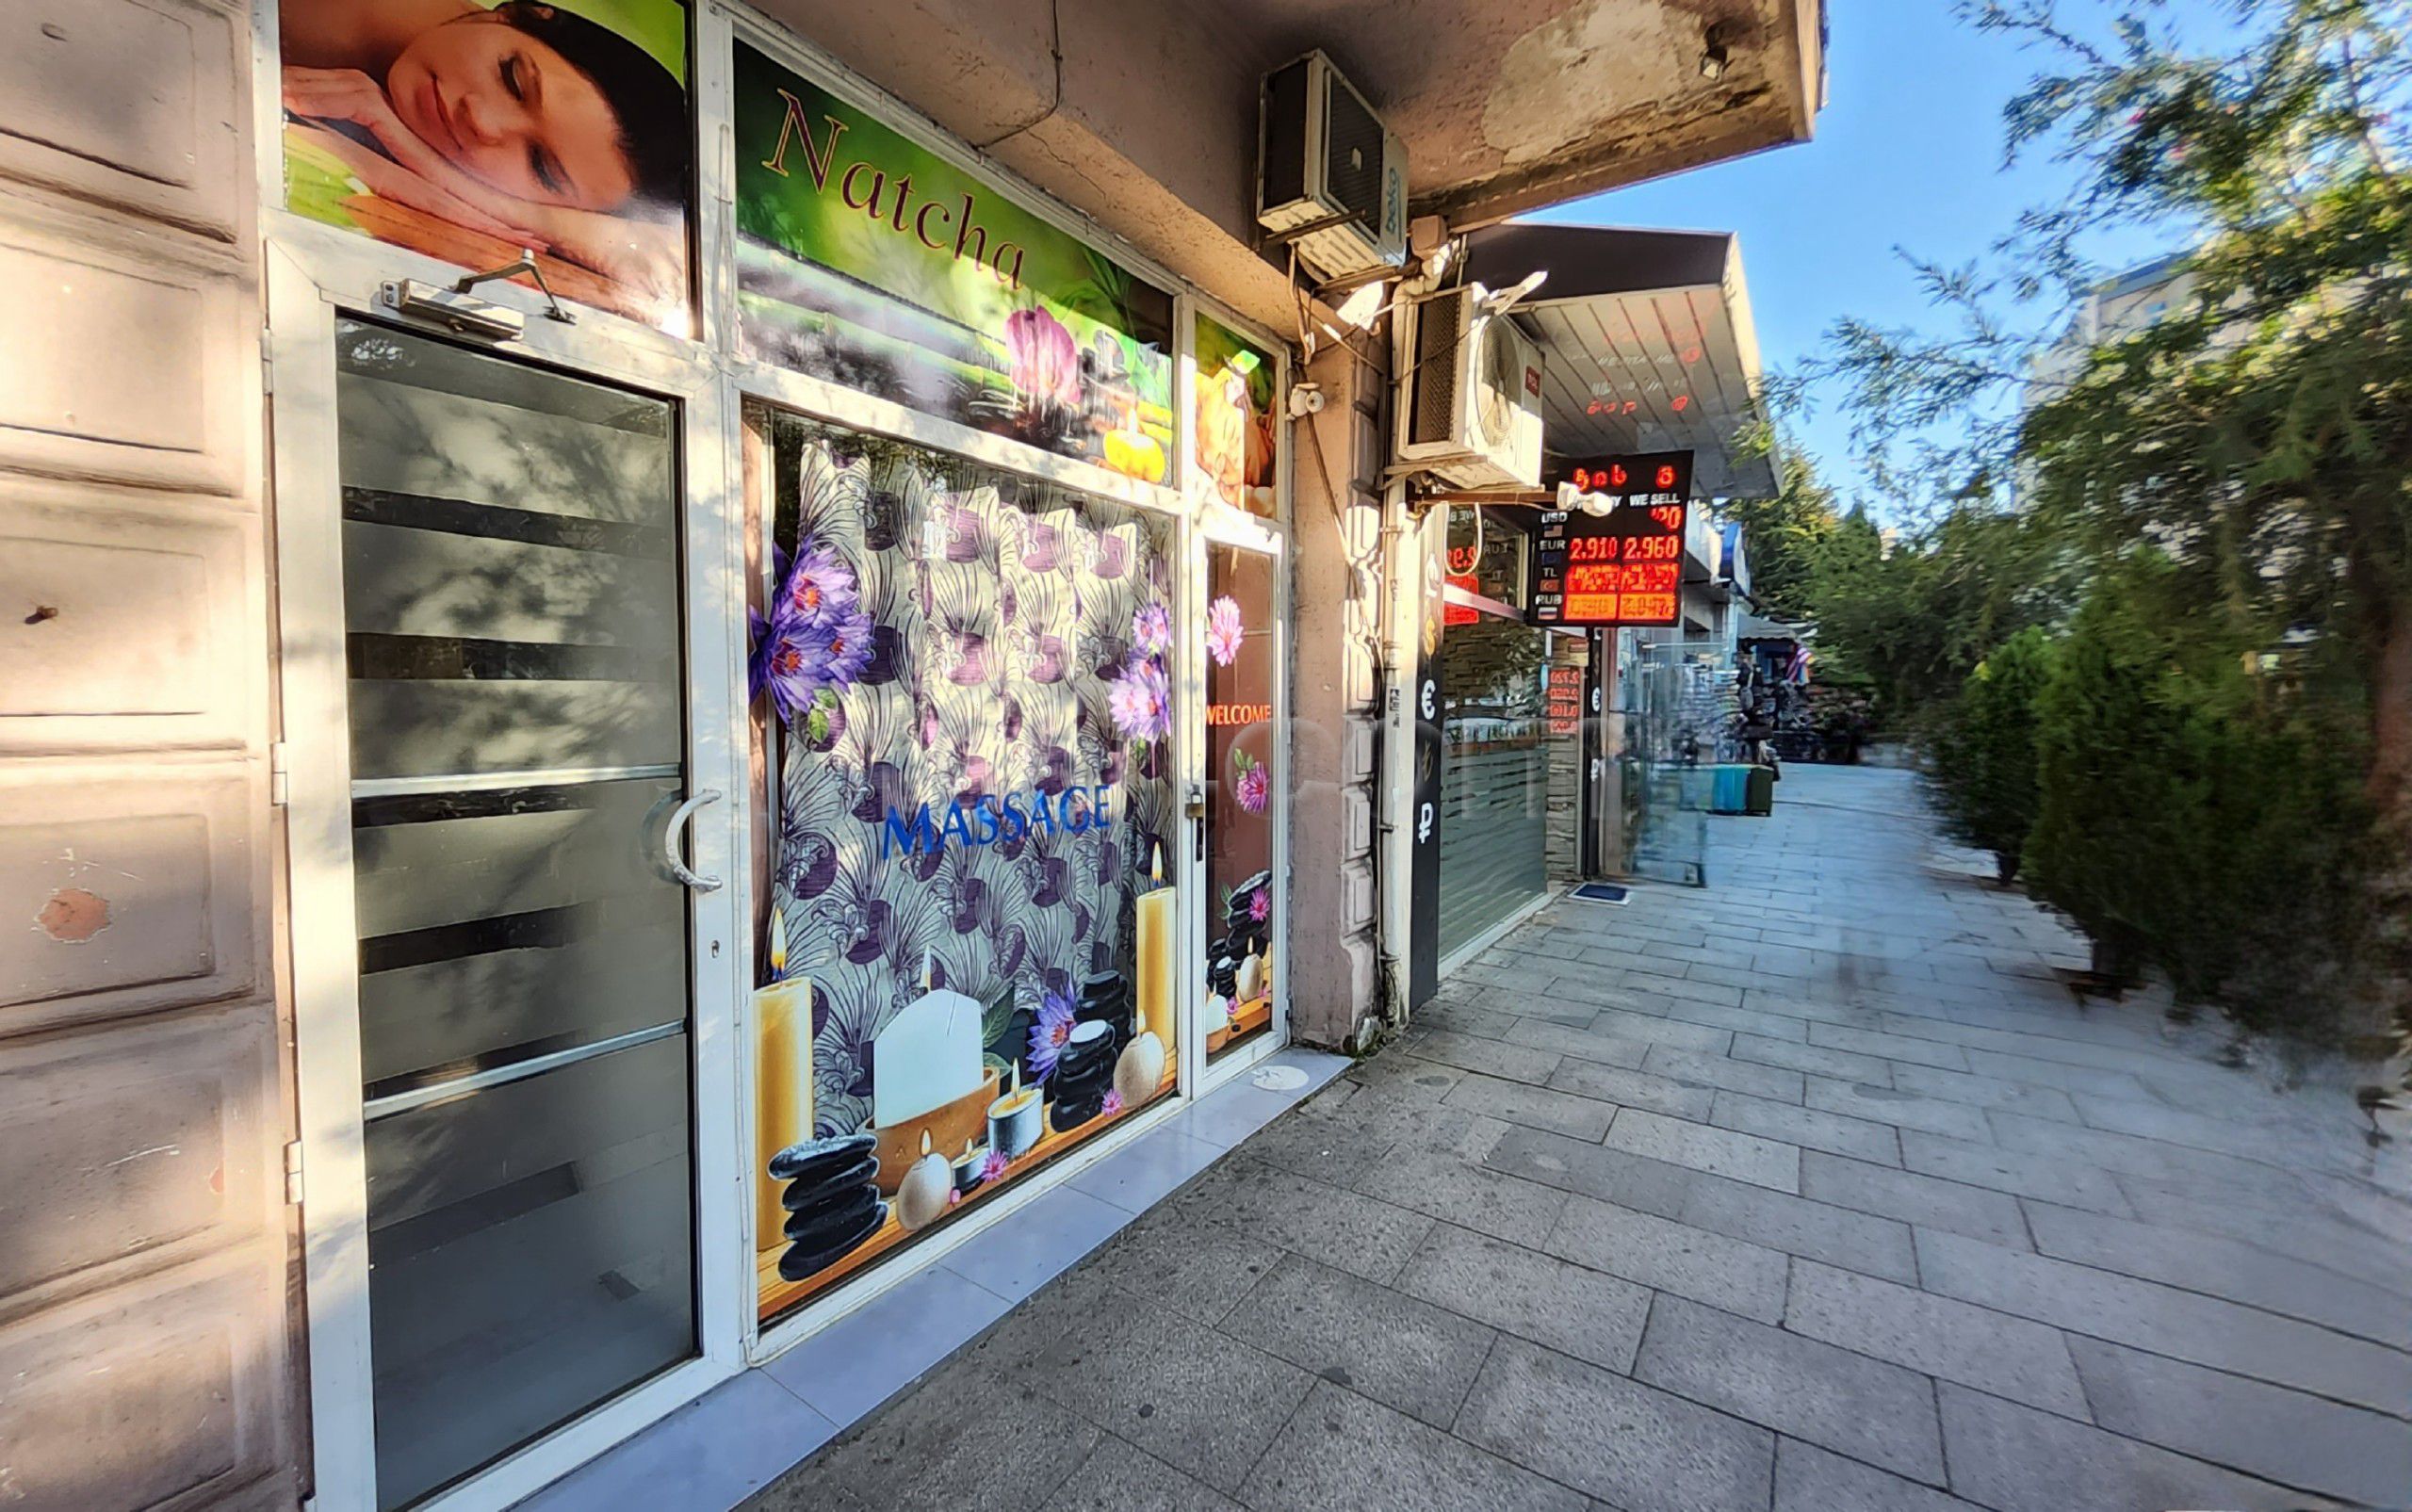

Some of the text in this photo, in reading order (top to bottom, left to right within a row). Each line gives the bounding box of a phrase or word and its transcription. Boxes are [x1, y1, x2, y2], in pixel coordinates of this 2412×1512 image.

[762, 88, 1025, 290] Natcha
[1629, 494, 1649, 507] WE
[1651, 493, 1681, 506] SELL
[1541, 512, 1568, 524] USD
[1540, 534, 1679, 561] EUR 2.910 2.960
[1543, 567, 1557, 577] TL
[1535, 594, 1562, 605] RUB
[1206, 705, 1272, 725] WELCOME
[882, 785, 1112, 860] MASSAGE
